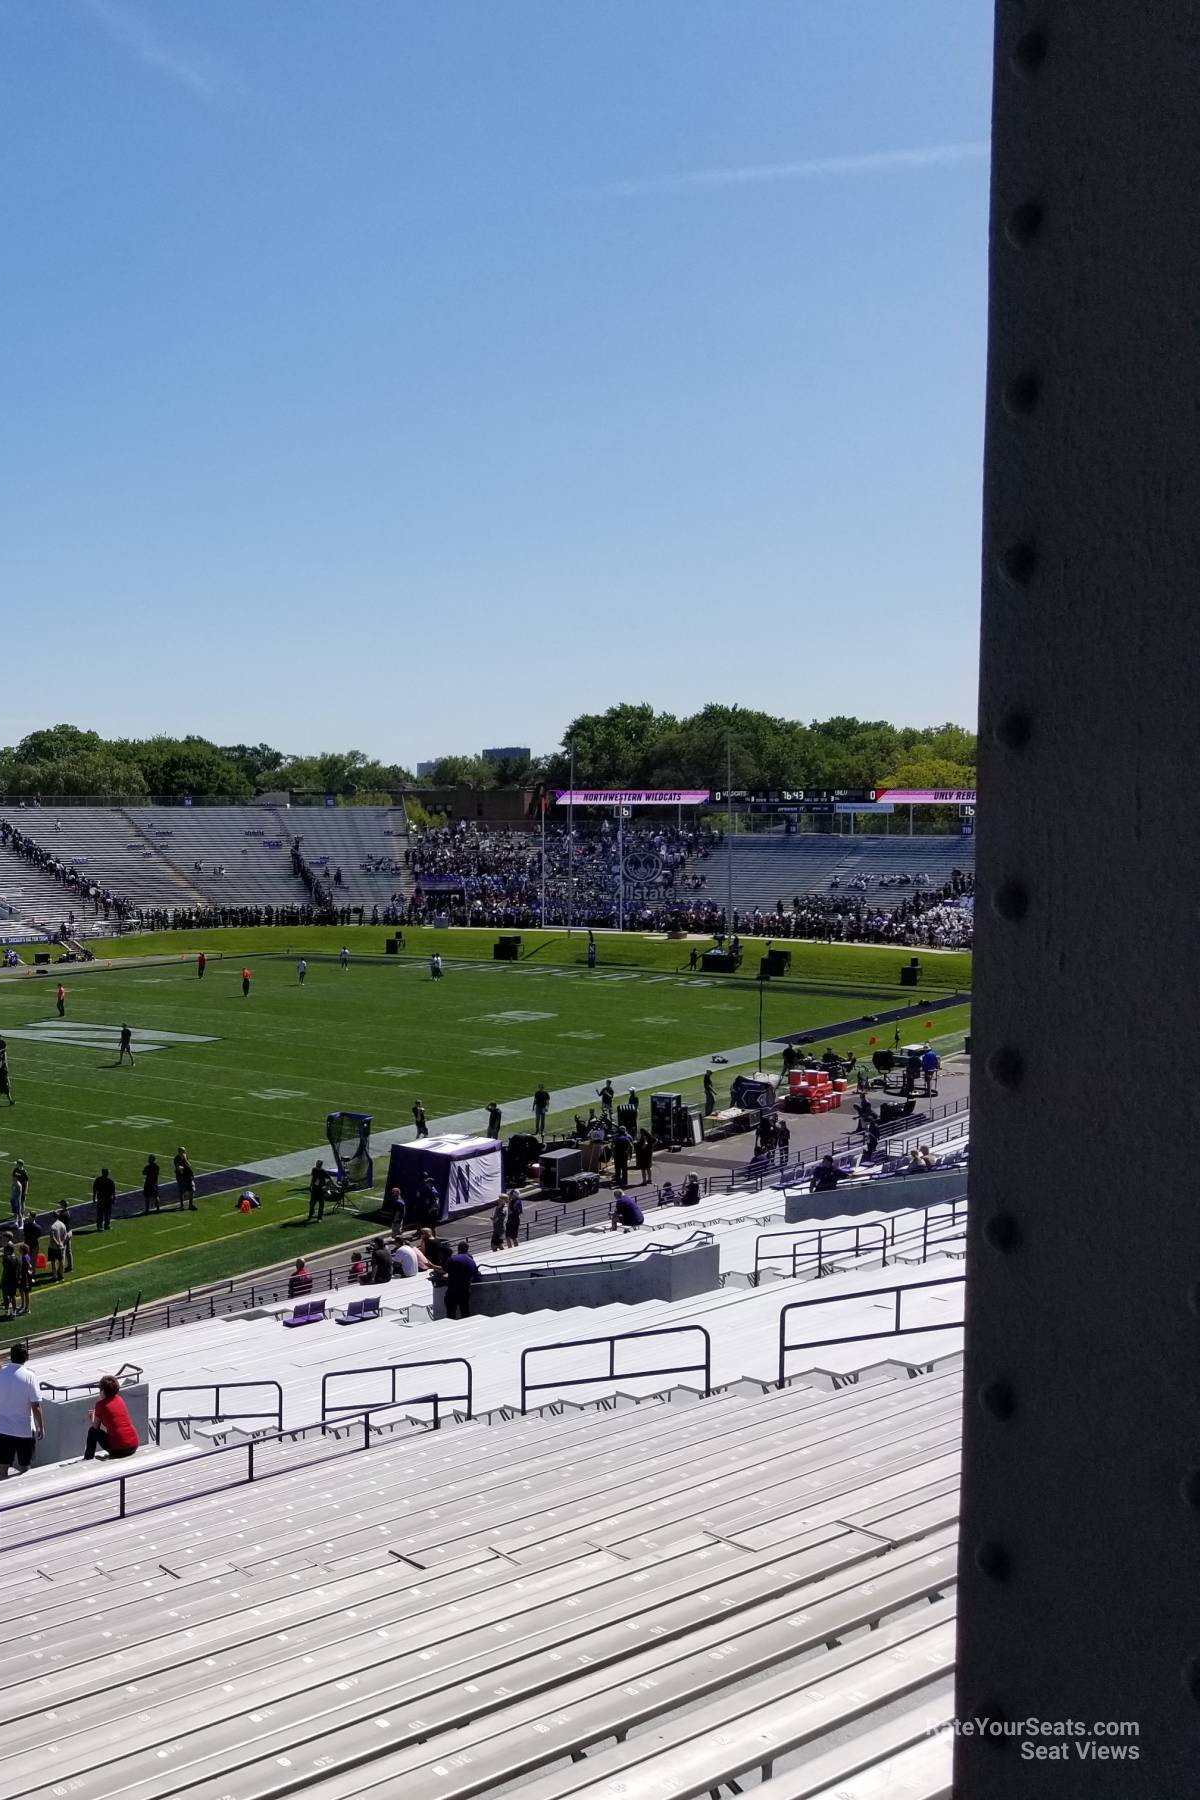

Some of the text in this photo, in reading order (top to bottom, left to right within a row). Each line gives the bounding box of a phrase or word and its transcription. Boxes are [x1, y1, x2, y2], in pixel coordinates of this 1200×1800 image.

[583, 792, 682, 801] NORTHWESTERN WILDCATS
[870, 791, 876, 800] 0
[934, 792, 976, 800] UNLV REBE
[614, 882, 676, 900] Allstate
[455, 1164, 470, 1204] N
